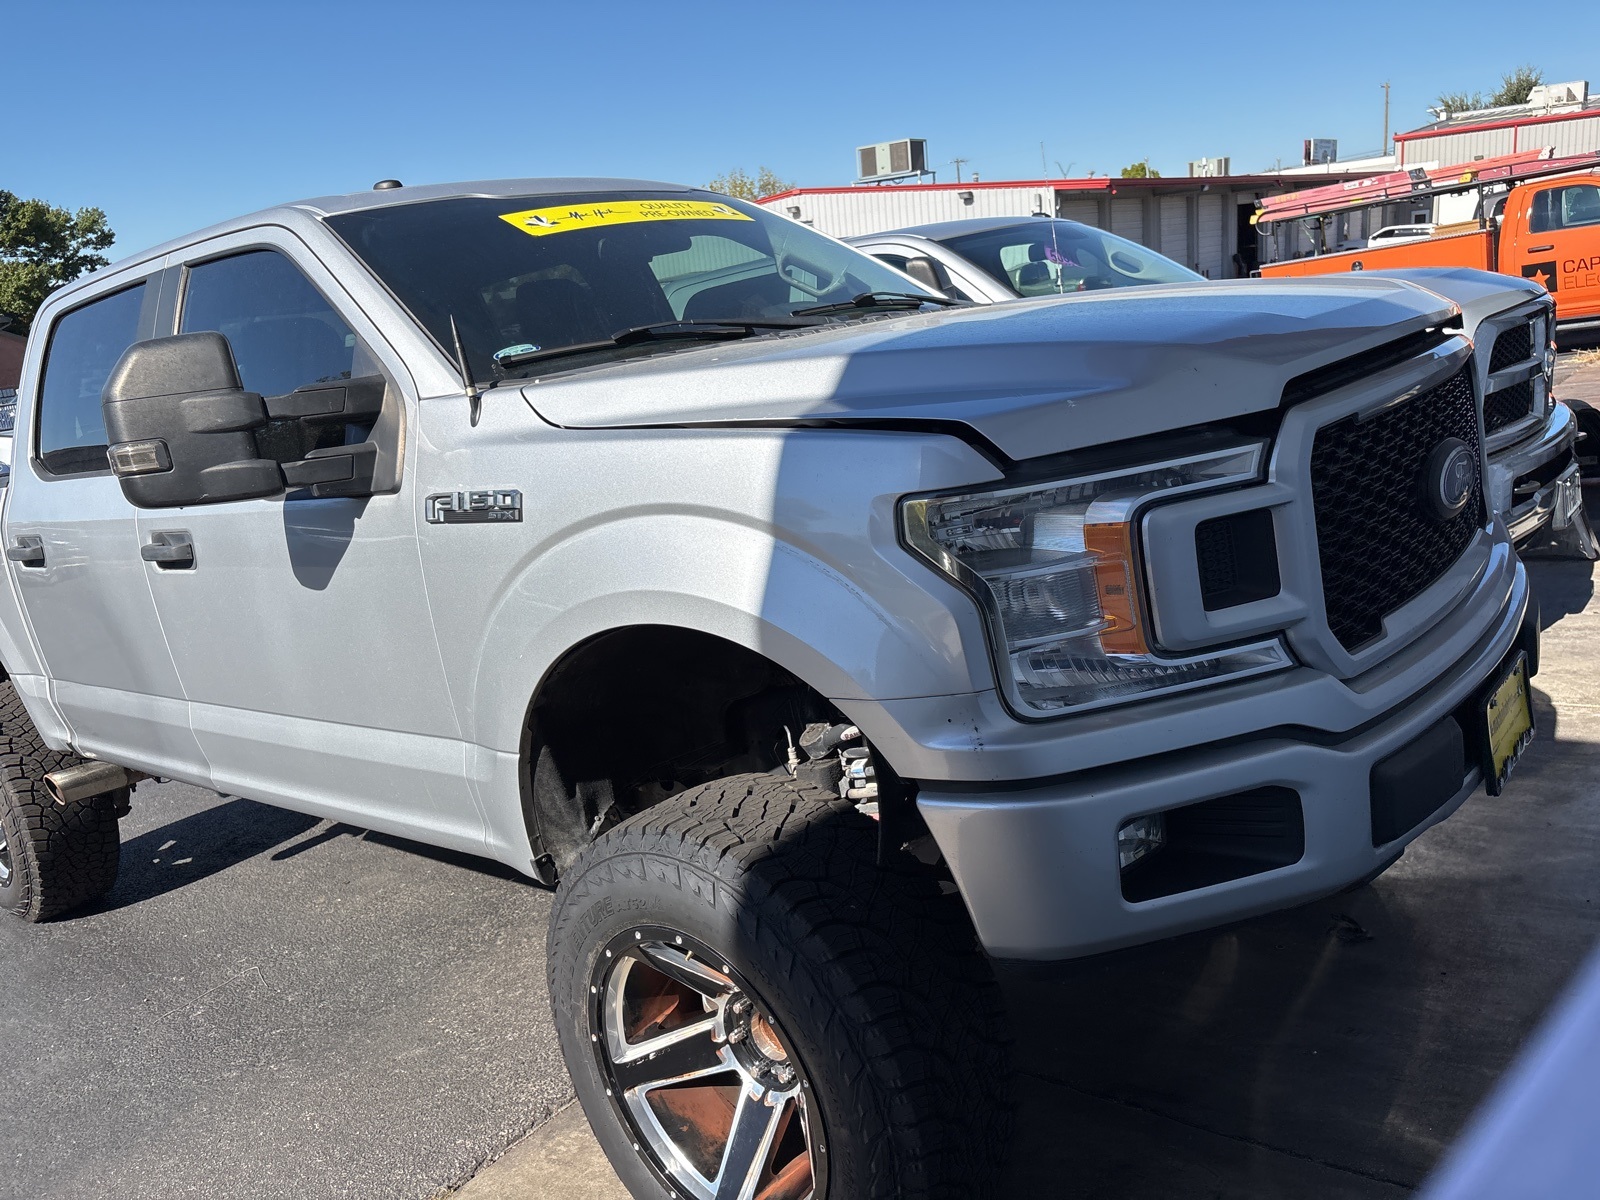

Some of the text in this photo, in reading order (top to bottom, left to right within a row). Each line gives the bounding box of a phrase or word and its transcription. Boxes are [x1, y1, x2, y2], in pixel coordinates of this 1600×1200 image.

[640, 202, 693, 210] QUALITY
[639, 210, 715, 218] PRE-OWNED
[488, 511, 515, 520] STX
